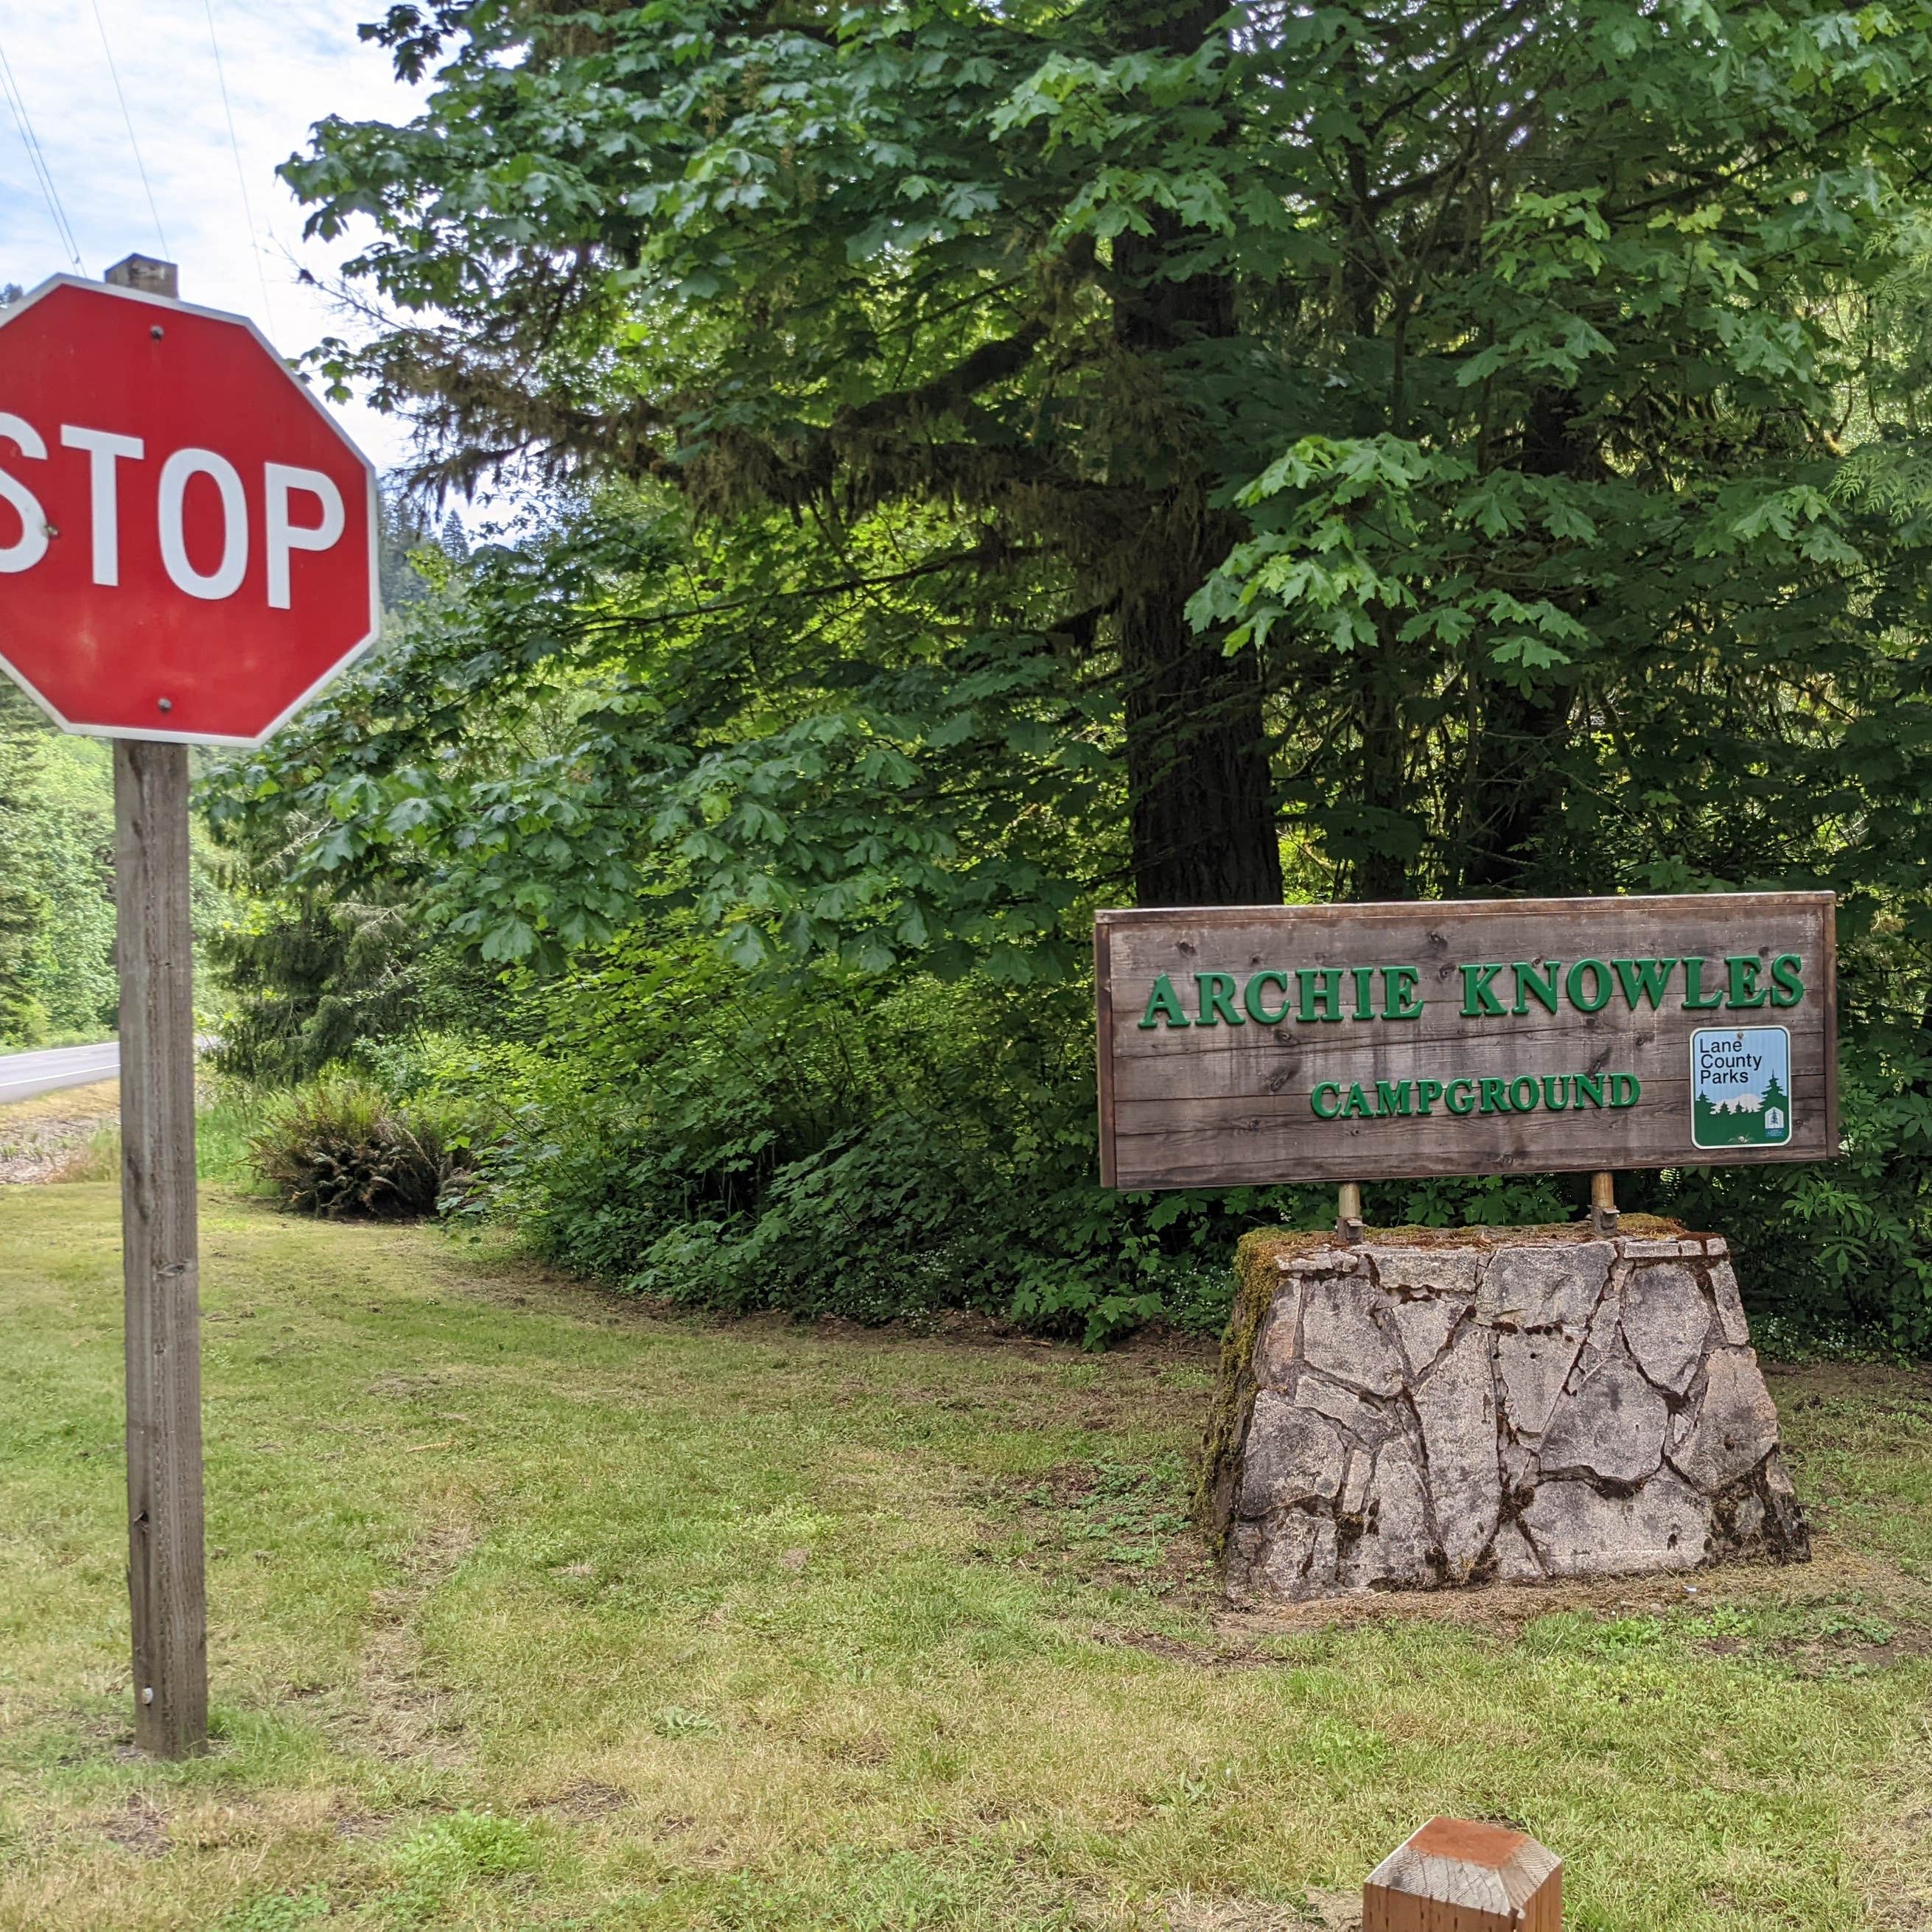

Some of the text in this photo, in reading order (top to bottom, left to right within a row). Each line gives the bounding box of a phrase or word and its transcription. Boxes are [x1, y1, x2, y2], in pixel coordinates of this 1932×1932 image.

[1138, 953, 1805, 1028] ARCHIE KNOWLES
[1700, 1039, 1743, 1053] Lane
[1701, 1054, 1763, 1071] County
[1701, 1069, 1749, 1084] Parks
[1311, 1073, 1641, 1118] CAMPGROUND
